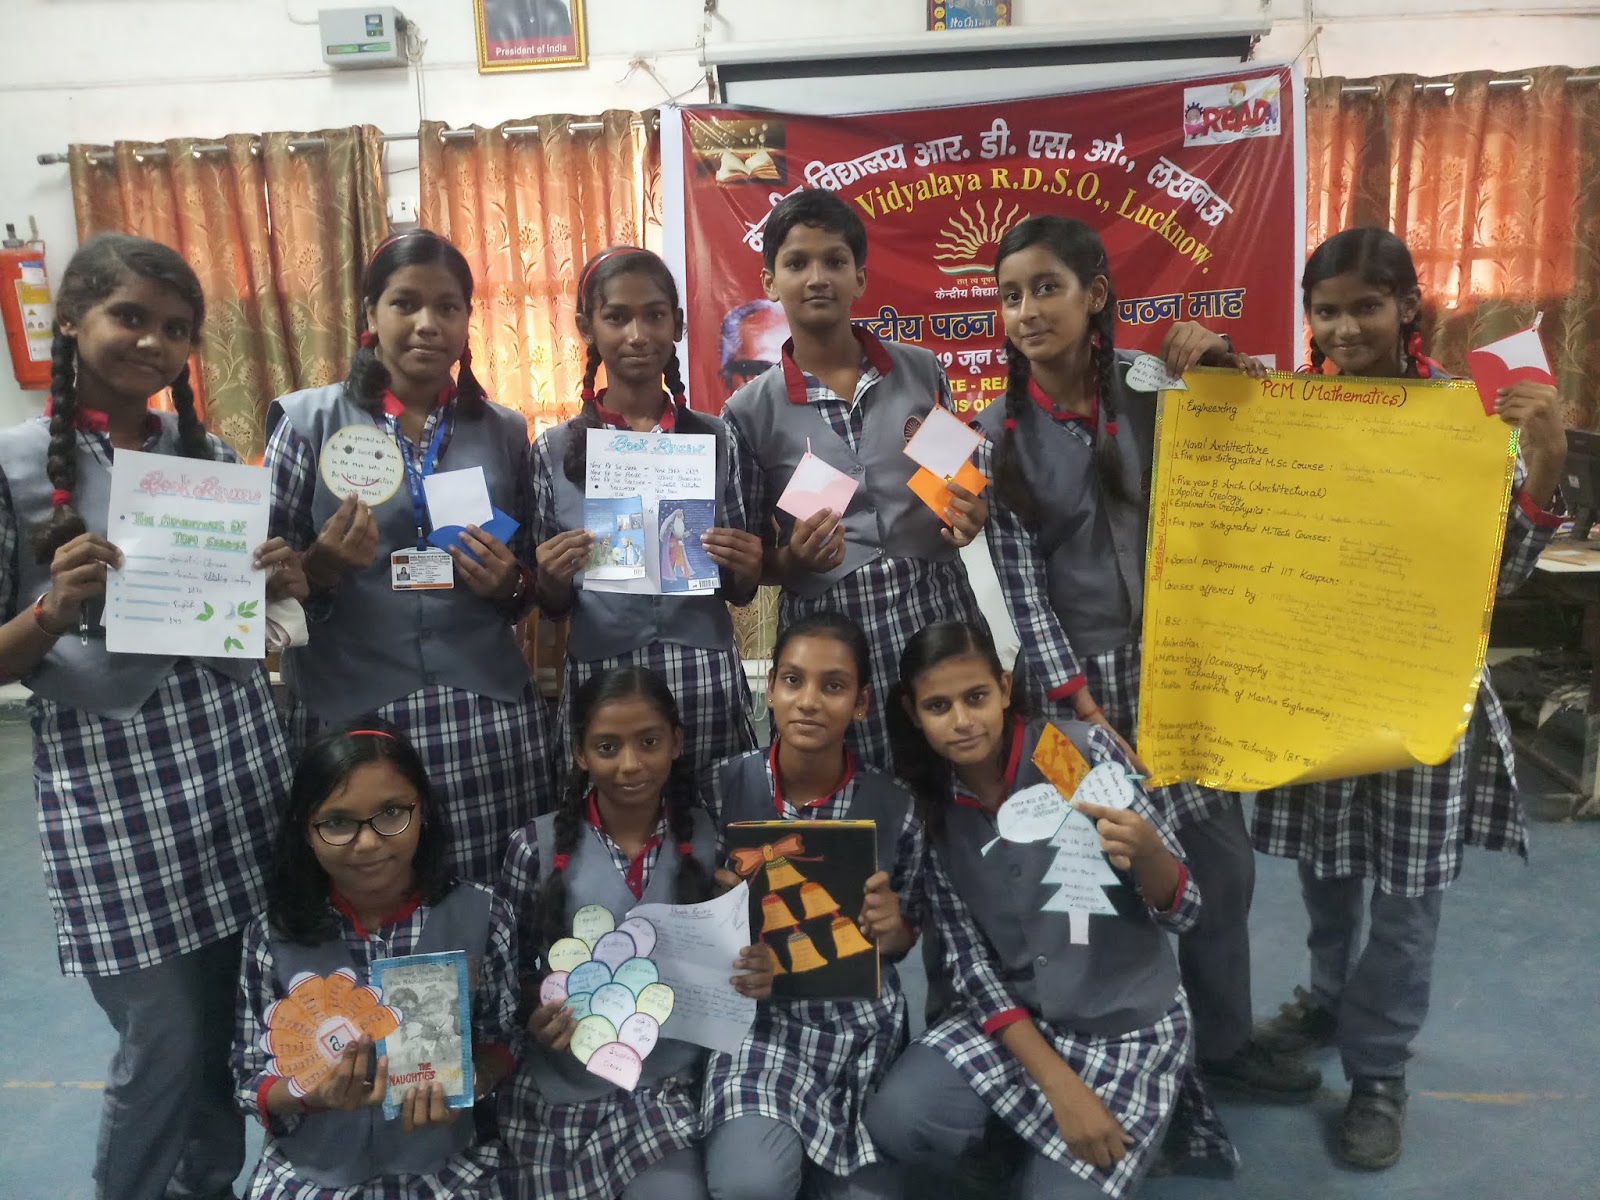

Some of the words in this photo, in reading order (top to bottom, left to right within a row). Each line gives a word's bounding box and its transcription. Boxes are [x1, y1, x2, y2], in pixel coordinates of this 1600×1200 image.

[495, 45, 535, 56] President
[536, 45, 545, 53] of
[546, 43, 567, 53] India
[914, 135, 971, 168] आर.
[979, 118, 1017, 160] डी.
[1027, 129, 1076, 160] एस.
[1147, 156, 1234, 227] लखनऊ
[854, 171, 982, 220] Vidyalaya
[990, 167, 1110, 214] R.D.S.O.,
[1116, 188, 1214, 275] Lucknow.
[934, 287, 968, 300] केन्द्रीय
[1117, 293, 1185, 326] पठन
[1188, 288, 1246, 319] माह
[928, 310, 997, 341] पठन
[956, 350, 993, 375] जून
[1261, 379, 1294, 400] PCM
[1303, 381, 1408, 408] (Mathematics)
[1187, 399, 1238, 421] Engineering
[1183, 438, 1207, 449] Naval
[1210, 438, 1269, 455] Architecture
[1196, 453, 1212, 465] year
[1215, 451, 1261, 470] Integrated
[1291, 458, 1325, 472] Course
[1177, 475, 1191, 487] Five
[1175, 486, 1204, 499] Applied
[1209, 488, 1244, 504] Geology
[1188, 520, 1205, 530] year
[1209, 519, 1258, 536] Integrated
[1260, 562, 1275, 574] at
[1280, 566, 1294, 576] IIT
[1199, 584, 1235, 597] offered
[1244, 587, 1256, 604] by
[1234, 689, 1244, 704] of
[418, 1062, 432, 1071] THE
